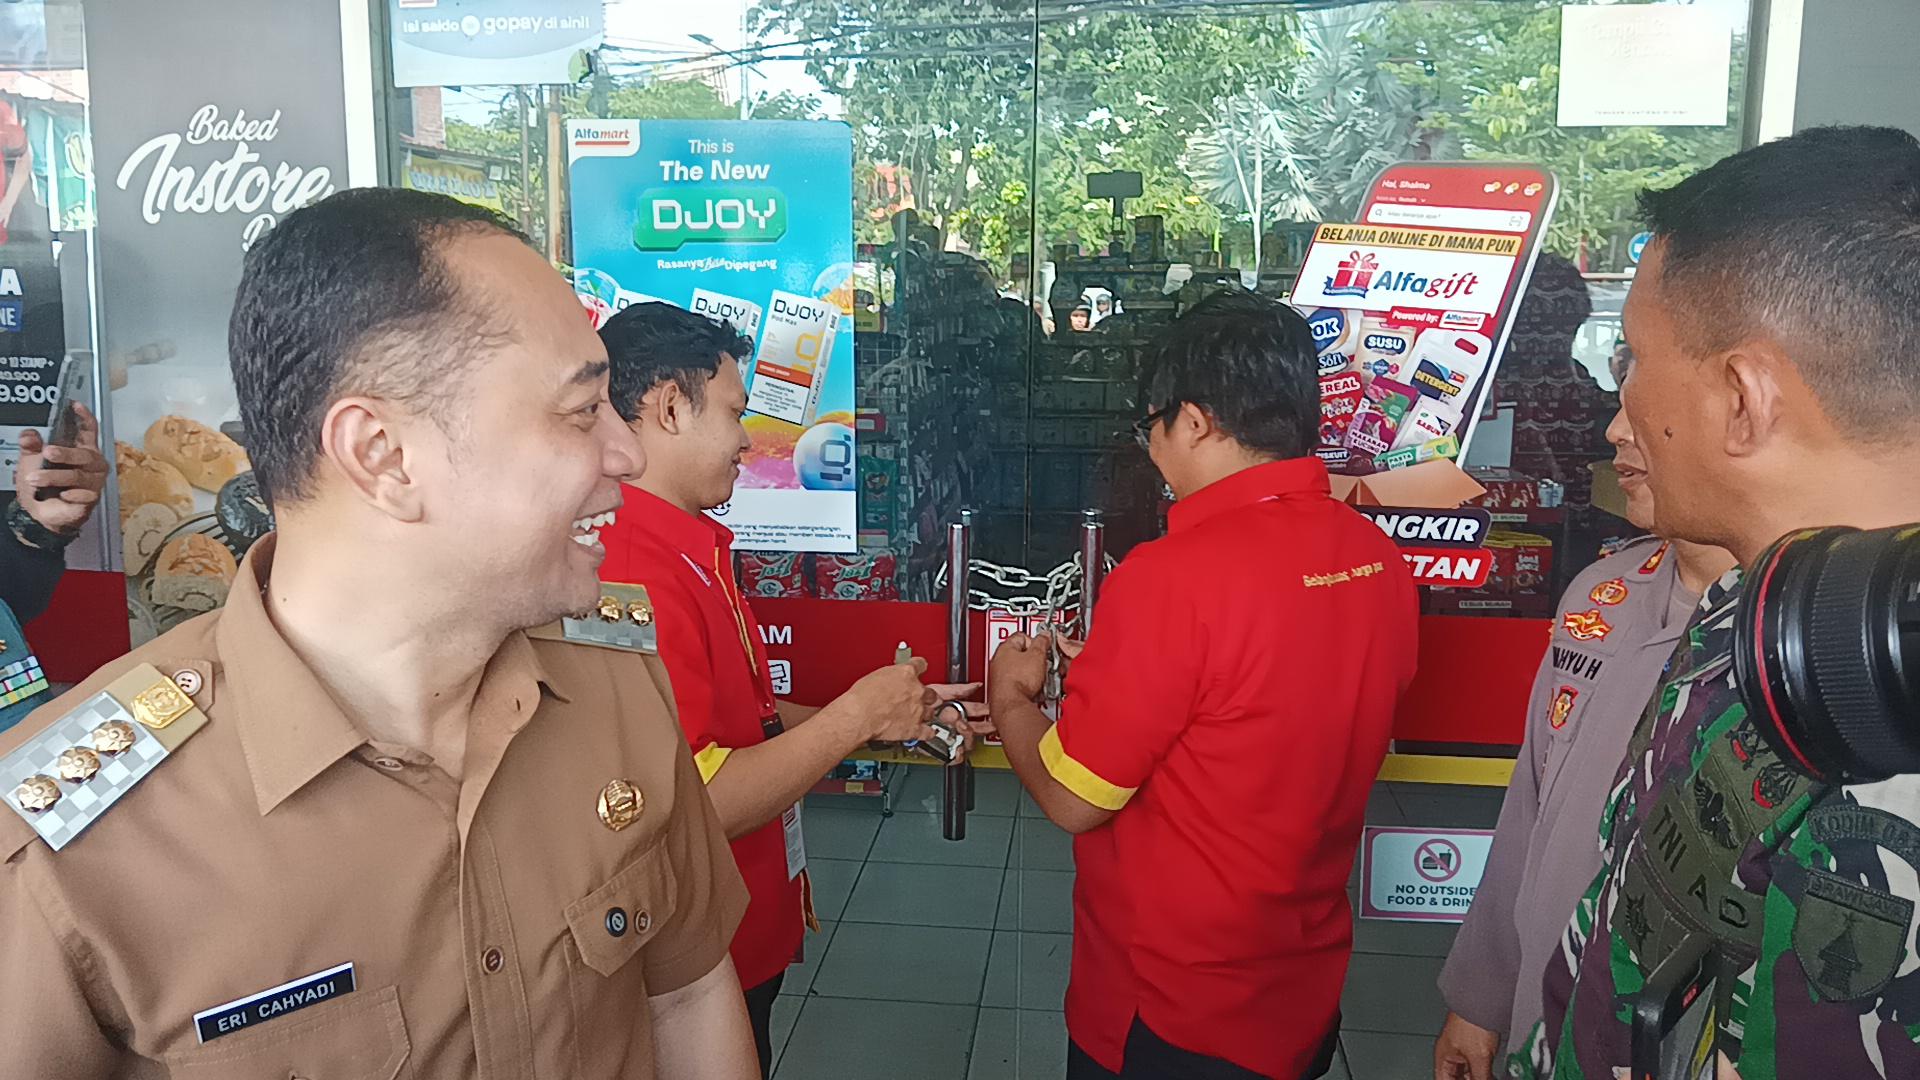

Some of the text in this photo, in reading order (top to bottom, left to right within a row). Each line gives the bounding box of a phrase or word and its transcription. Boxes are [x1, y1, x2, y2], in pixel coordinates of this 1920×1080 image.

[483, 16, 542, 36] gopay
[544, 19, 558, 30] di
[186, 104, 281, 145] Baked
[574, 127, 630, 141] Alfamart
[688, 139, 735, 154] This is
[116, 133, 335, 225] Instore
[659, 159, 770, 182] The New
[652, 199, 777, 230] DJOY
[1320, 227, 1517, 253] BELANJA ONLINE DI MANA PUN
[1373, 270, 1479, 299] Alfagift
[695, 297, 746, 320] DJOY
[774, 298, 824, 323] DJOY
[1391, 310, 1427, 322] Powered
[1368, 336, 1402, 350] SUSU
[1361, 513, 1480, 542] NGKIR
[1402, 554, 1481, 581] TAN
[1584, 658, 1603, 681] H
[1652, 803, 1688, 874] TNI
[1387, 895, 1425, 905] FOOD
[1429, 897, 1438, 905] &
[1395, 884, 1477, 896] NO OUTSIDE
[217, 980, 336, 1032] ERI CAHYADI
